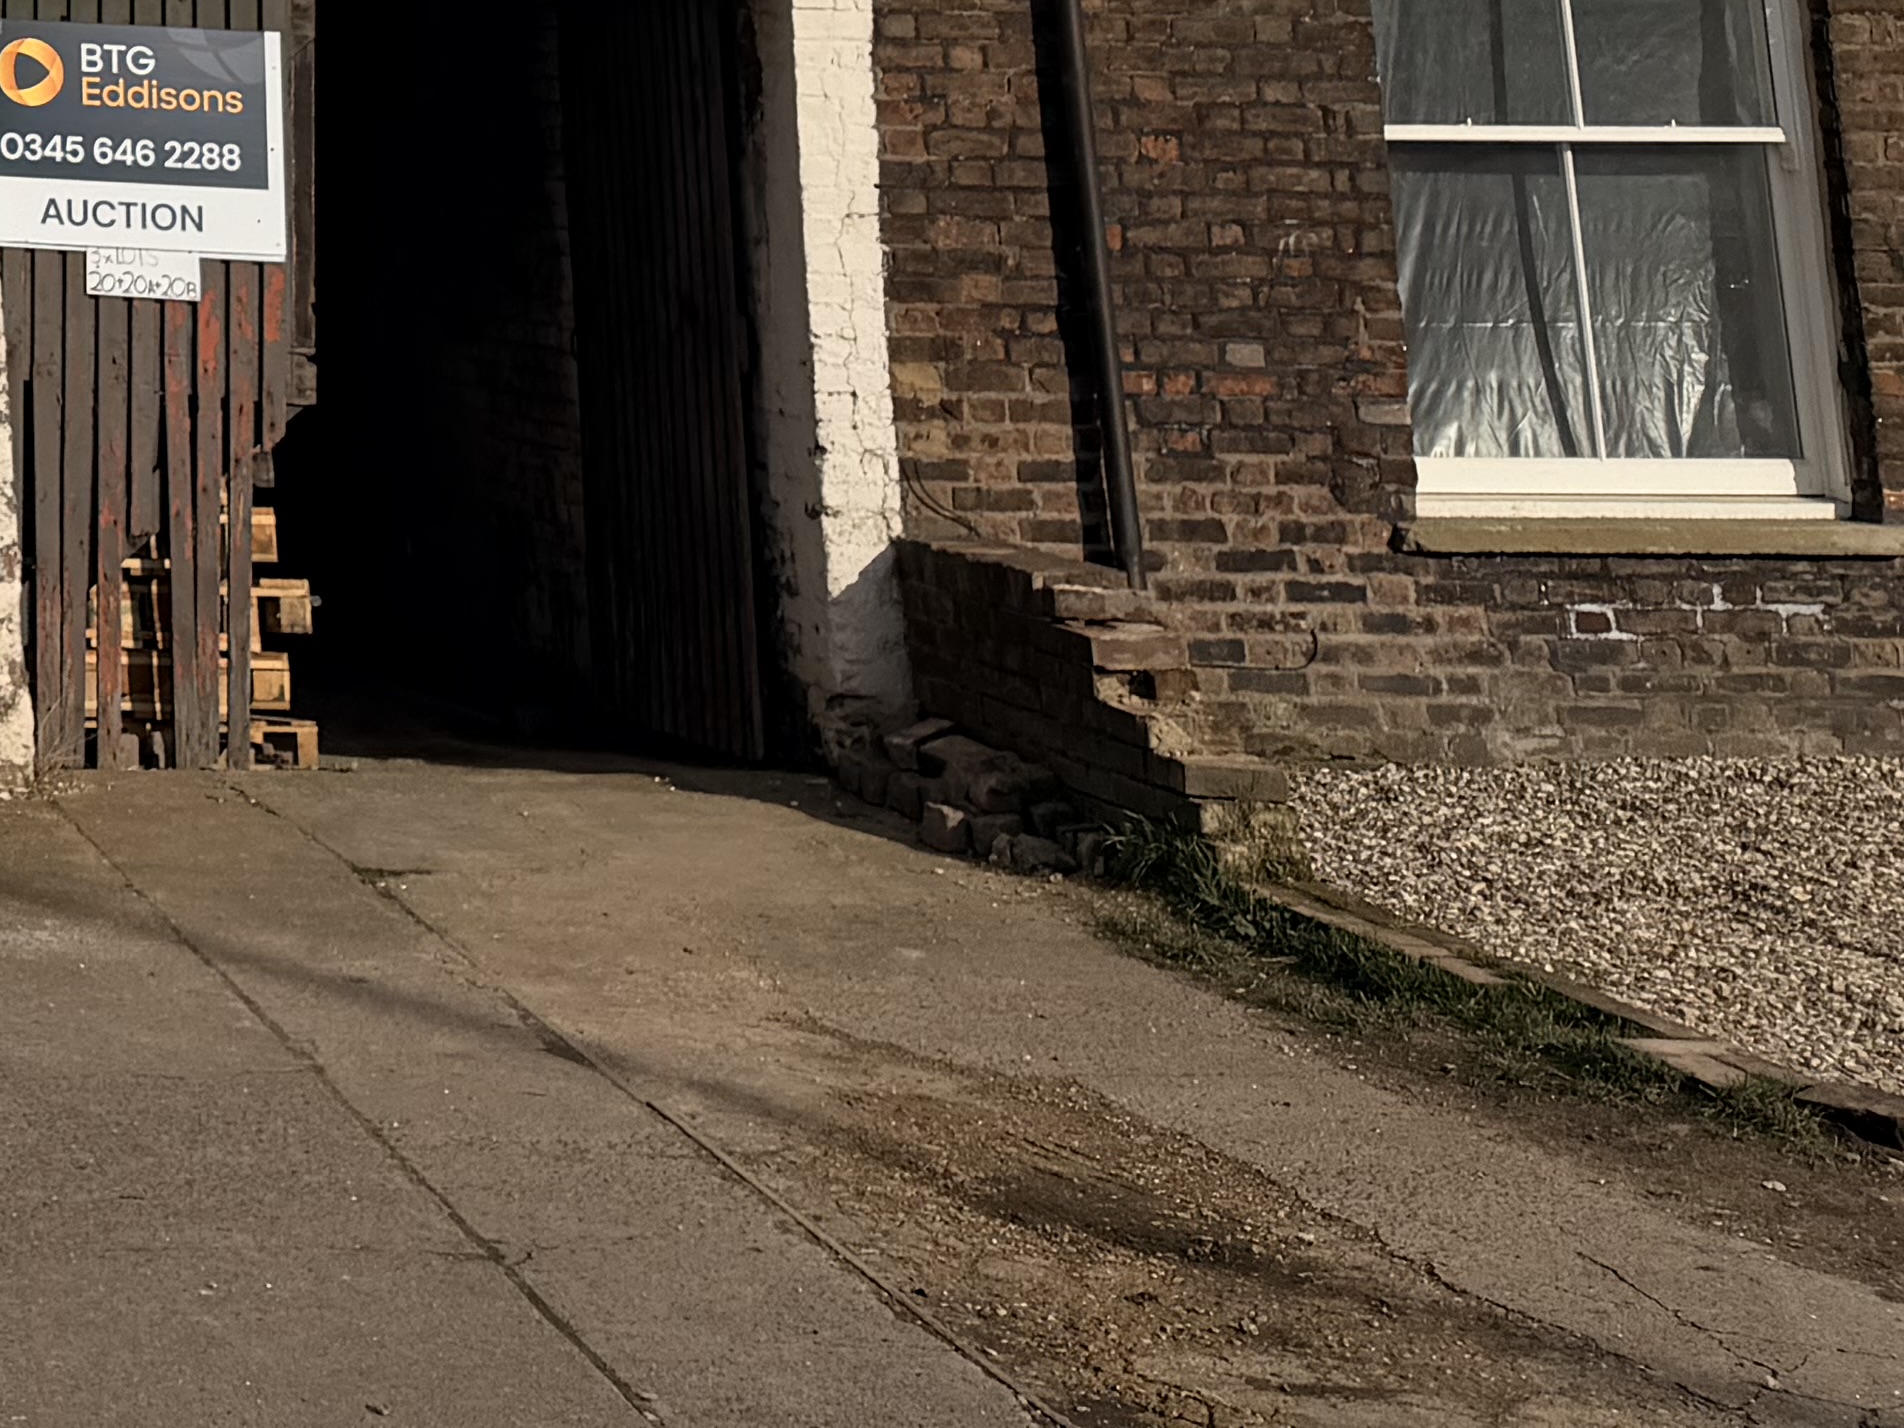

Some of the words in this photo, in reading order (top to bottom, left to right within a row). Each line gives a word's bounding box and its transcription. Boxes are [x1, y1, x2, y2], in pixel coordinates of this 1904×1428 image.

[80, 42, 157, 76] BTG
[80, 76, 244, 114] Eddisons
[0, 131, 85, 164] 0345
[93, 135, 156, 167] 646
[163, 140, 242, 172] 2288
[40, 197, 204, 233] AUCTION
